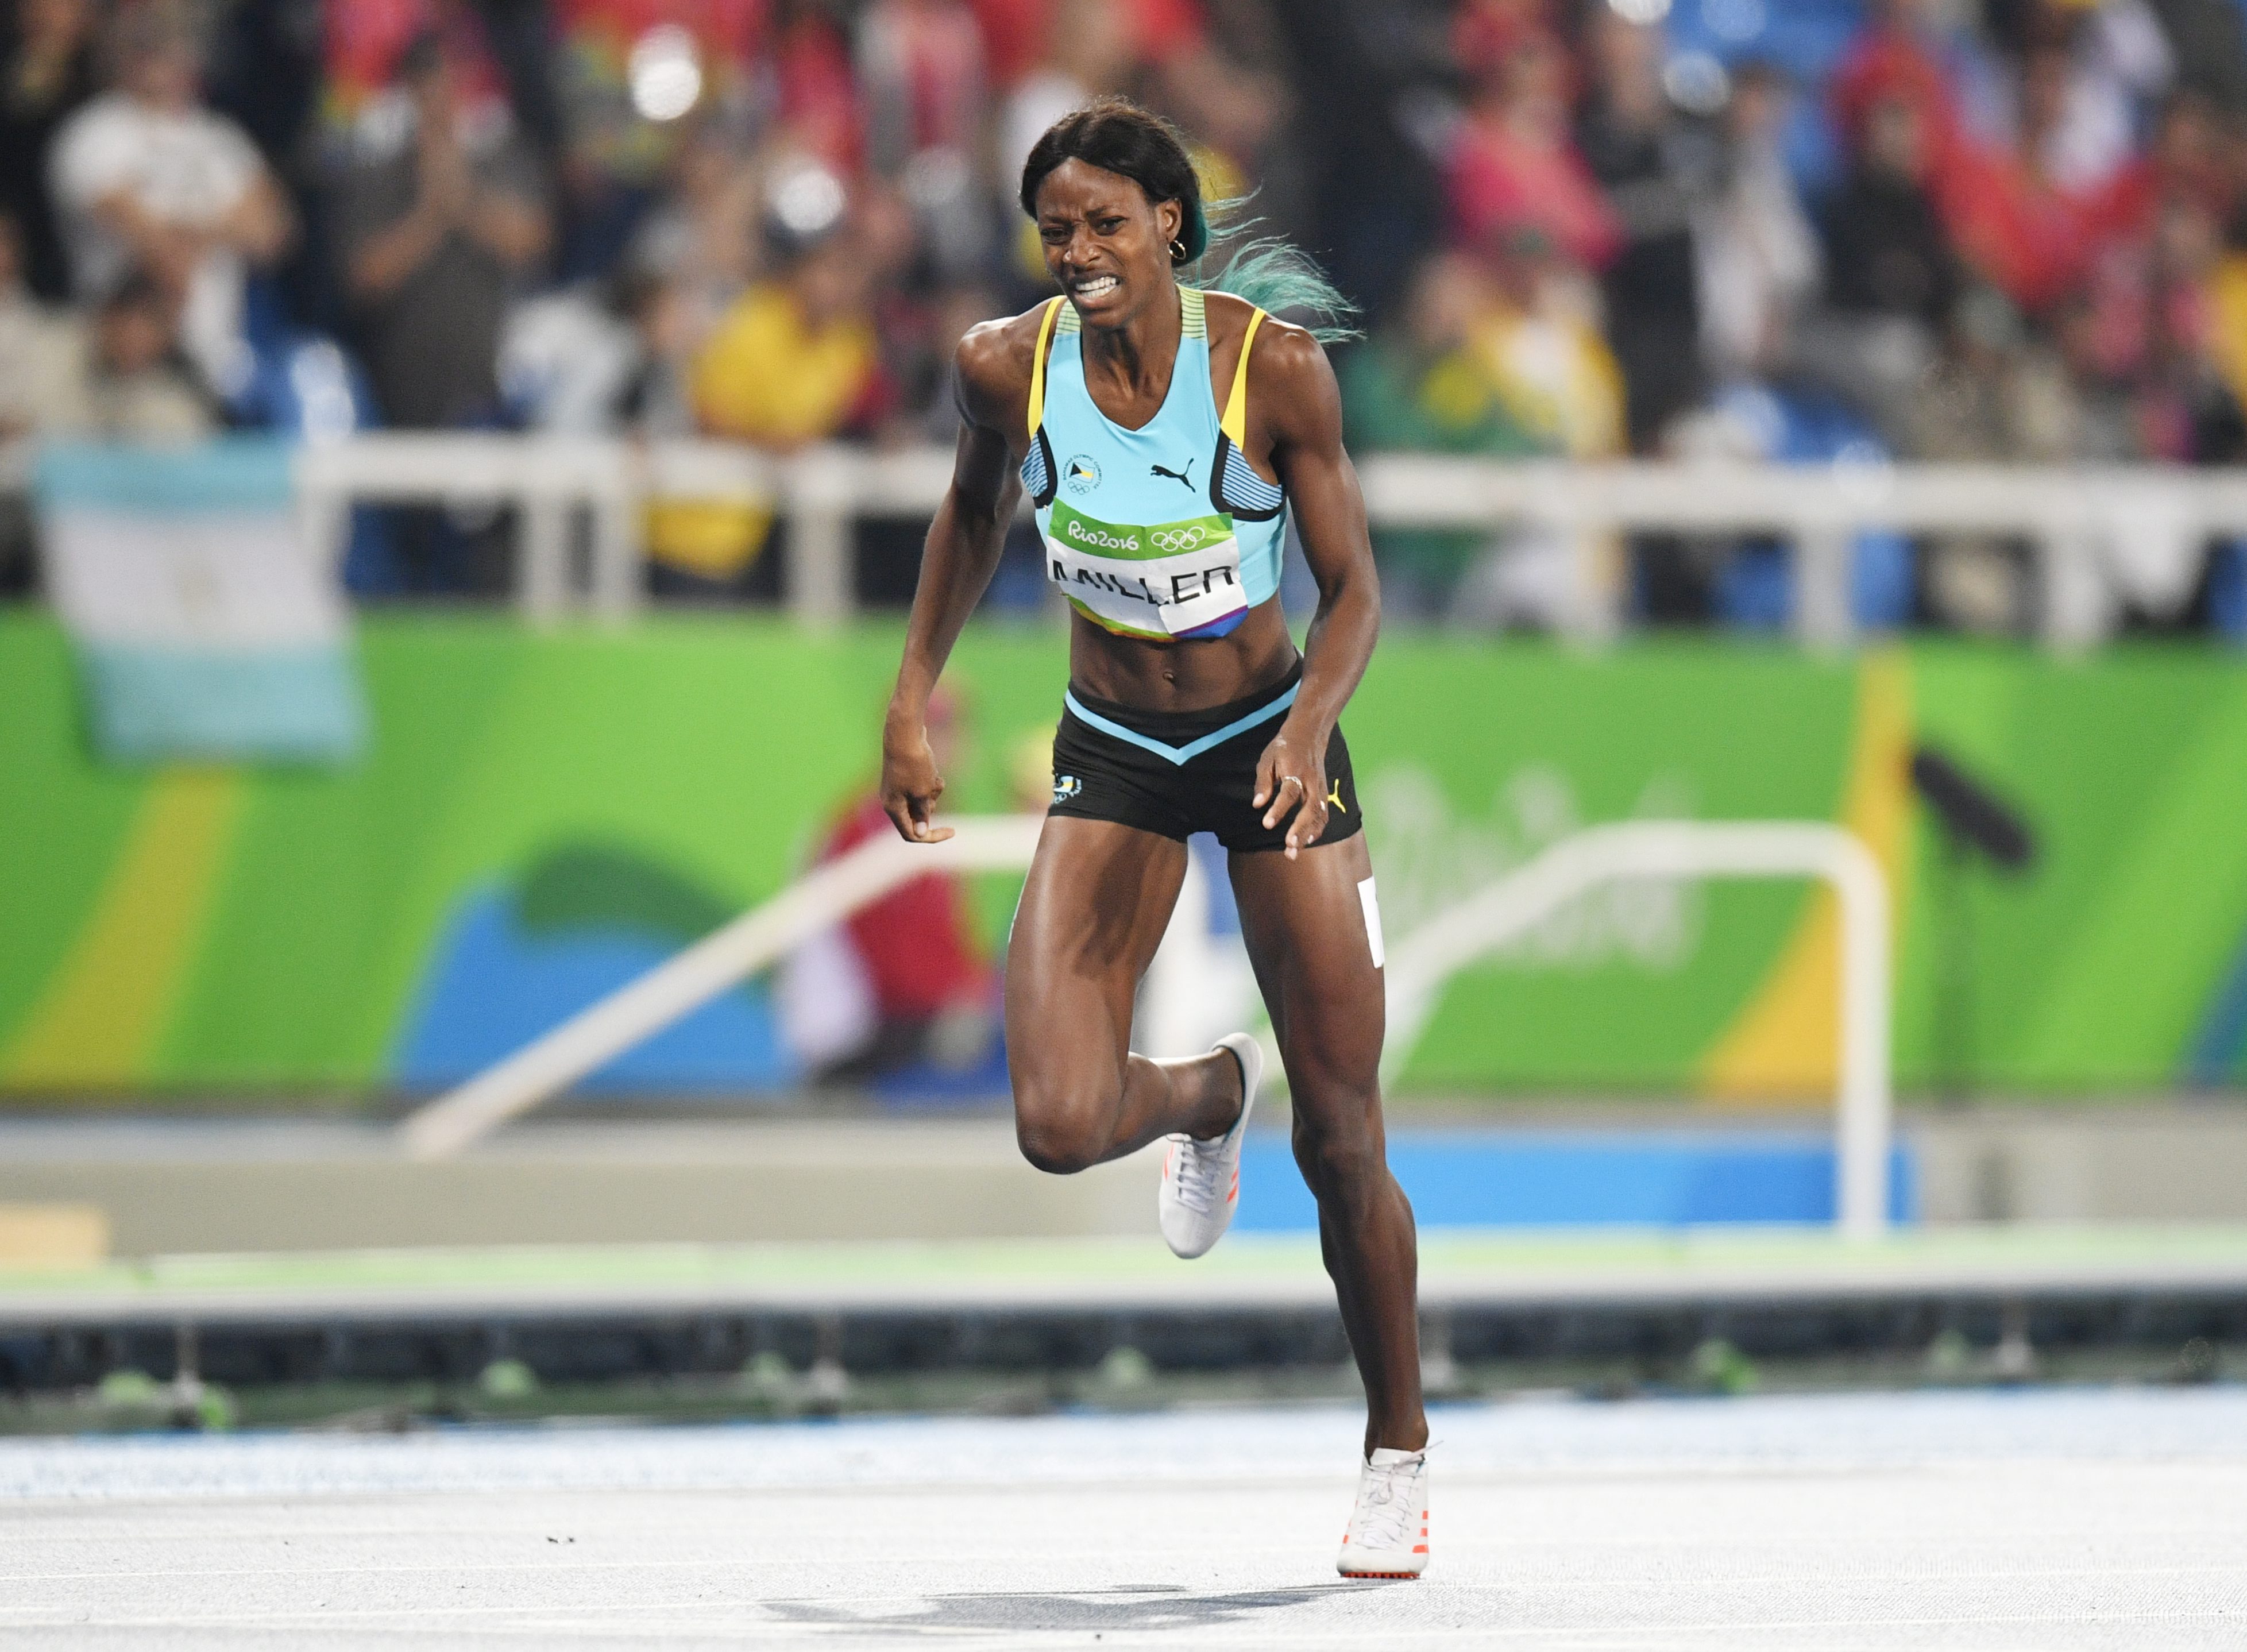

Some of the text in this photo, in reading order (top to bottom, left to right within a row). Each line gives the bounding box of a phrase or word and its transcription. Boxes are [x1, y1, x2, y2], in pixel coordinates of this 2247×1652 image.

[1063, 454, 1102, 489] BAHAMAS OLYMPIC COMMITTEE
[1052, 559, 1234, 607] MILLER
